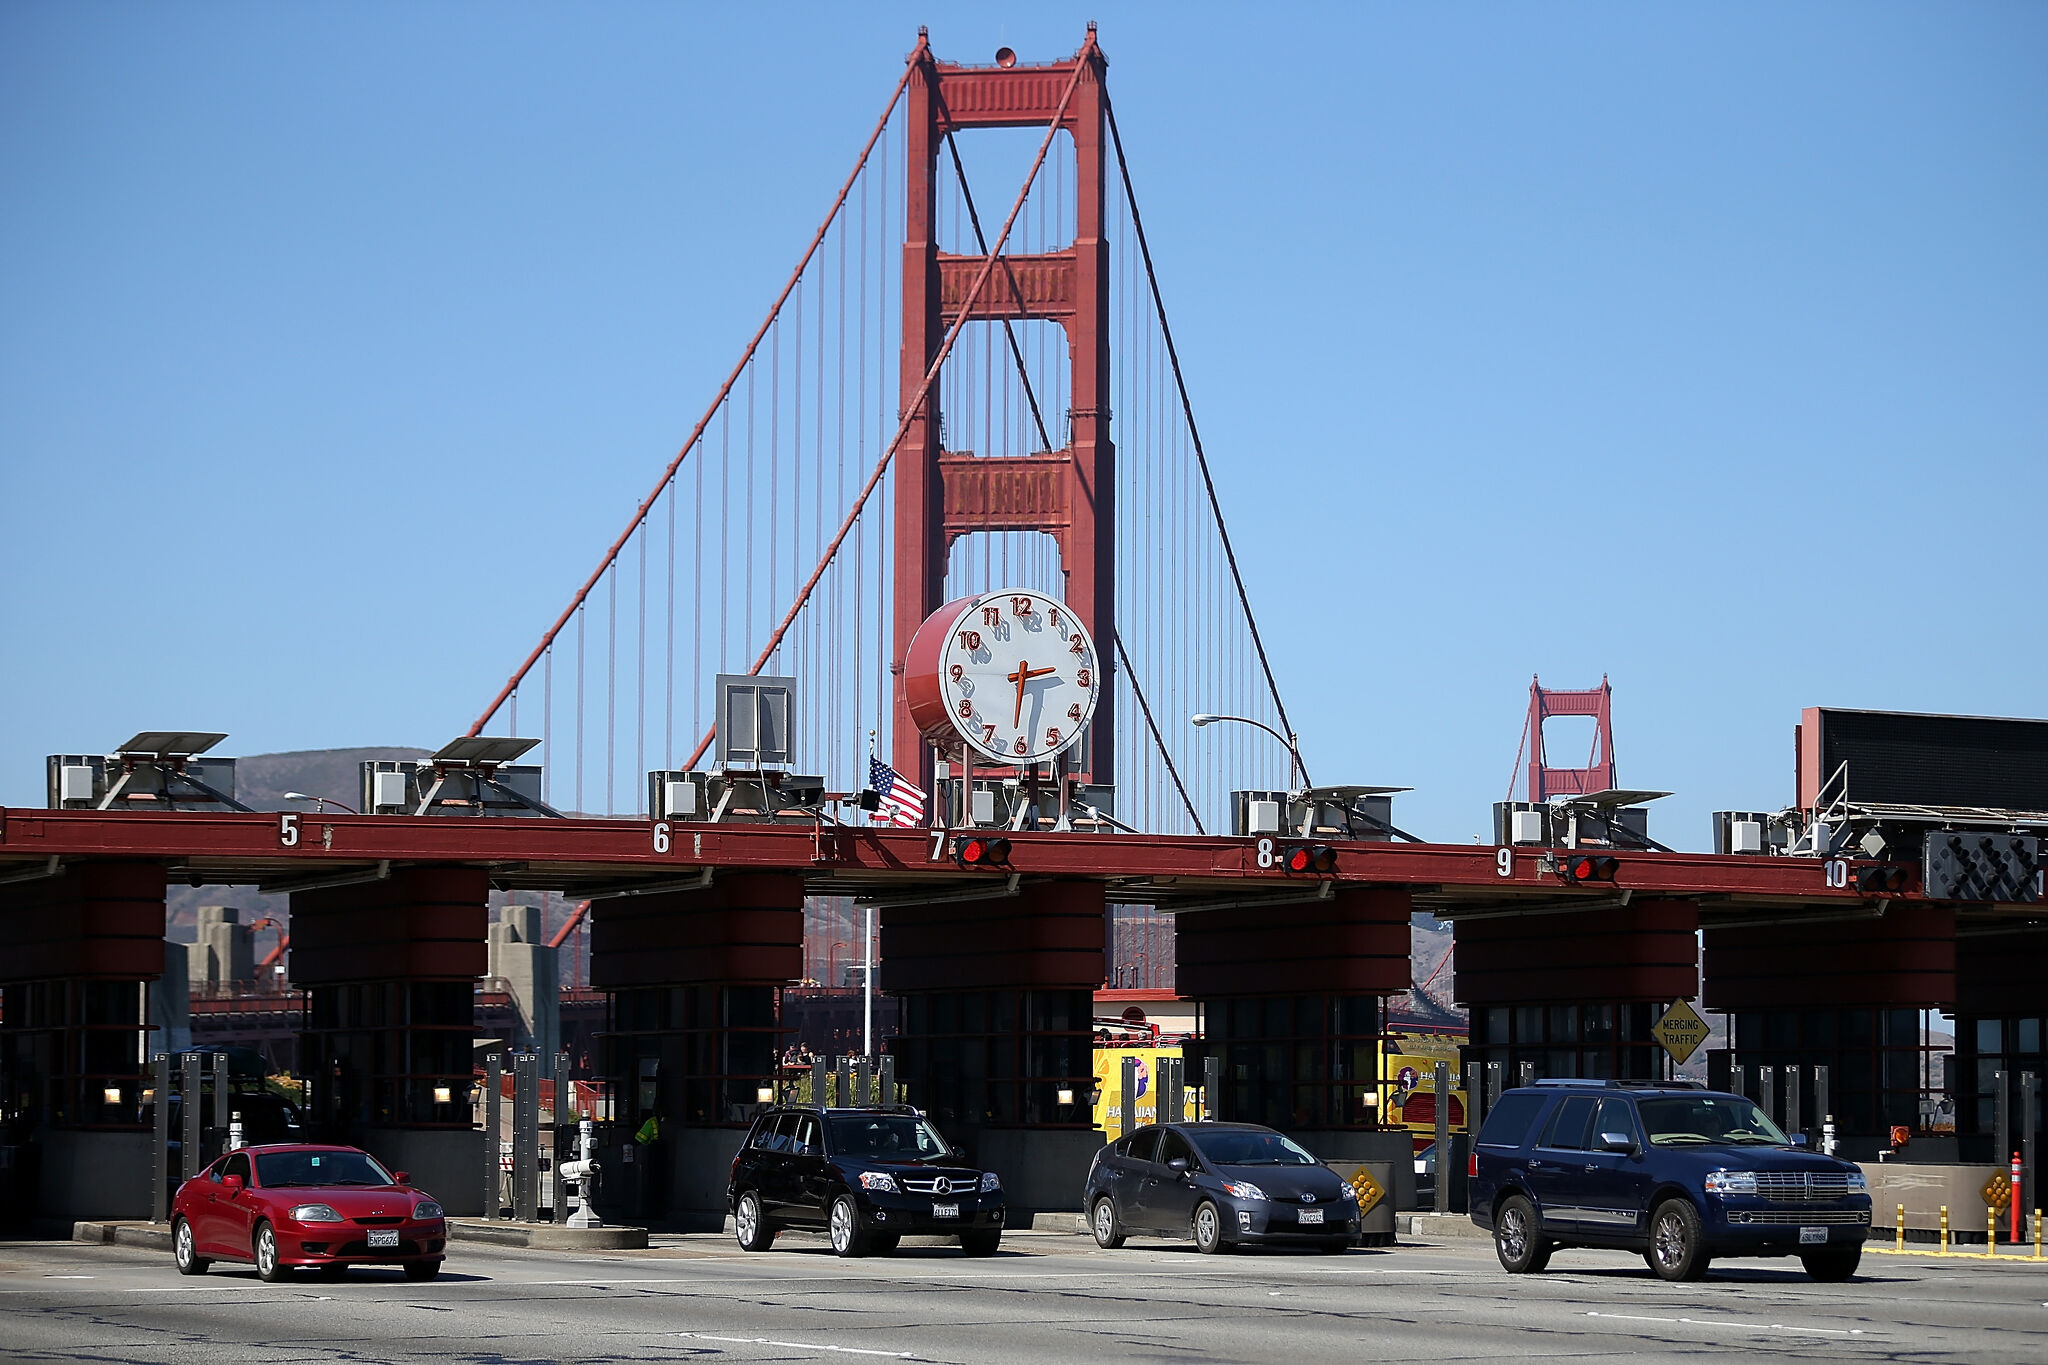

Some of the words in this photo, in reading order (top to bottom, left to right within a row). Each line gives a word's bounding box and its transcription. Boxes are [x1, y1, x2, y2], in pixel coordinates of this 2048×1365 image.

[1010, 597, 1033, 616] 12
[982, 607, 1000, 626] 11
[1049, 608, 1058, 626] 1
[958, 631, 981, 650] 10
[1069, 634, 1083, 652] 2
[950, 665, 963, 682] 9
[1077, 669, 1090, 687] 3
[958, 700, 972, 718] 8
[1067, 703, 1081, 721] 4
[983, 725, 996, 743] 7
[1046, 728, 1059, 746] 5
[1014, 736, 1027, 755] 6
[281, 815, 298, 846] 5
[653, 823, 670, 853] 6
[930, 831, 945, 860] 7
[1257, 838, 1273, 868] 8
[1497, 848, 1512, 877] 9
[1824, 860, 1847, 888] 10
[1663, 1020, 1698, 1030] MERGING
[1664, 1034, 1698, 1044] TRAFFIC
[1107, 1105, 1156, 1118] HAIIAN
